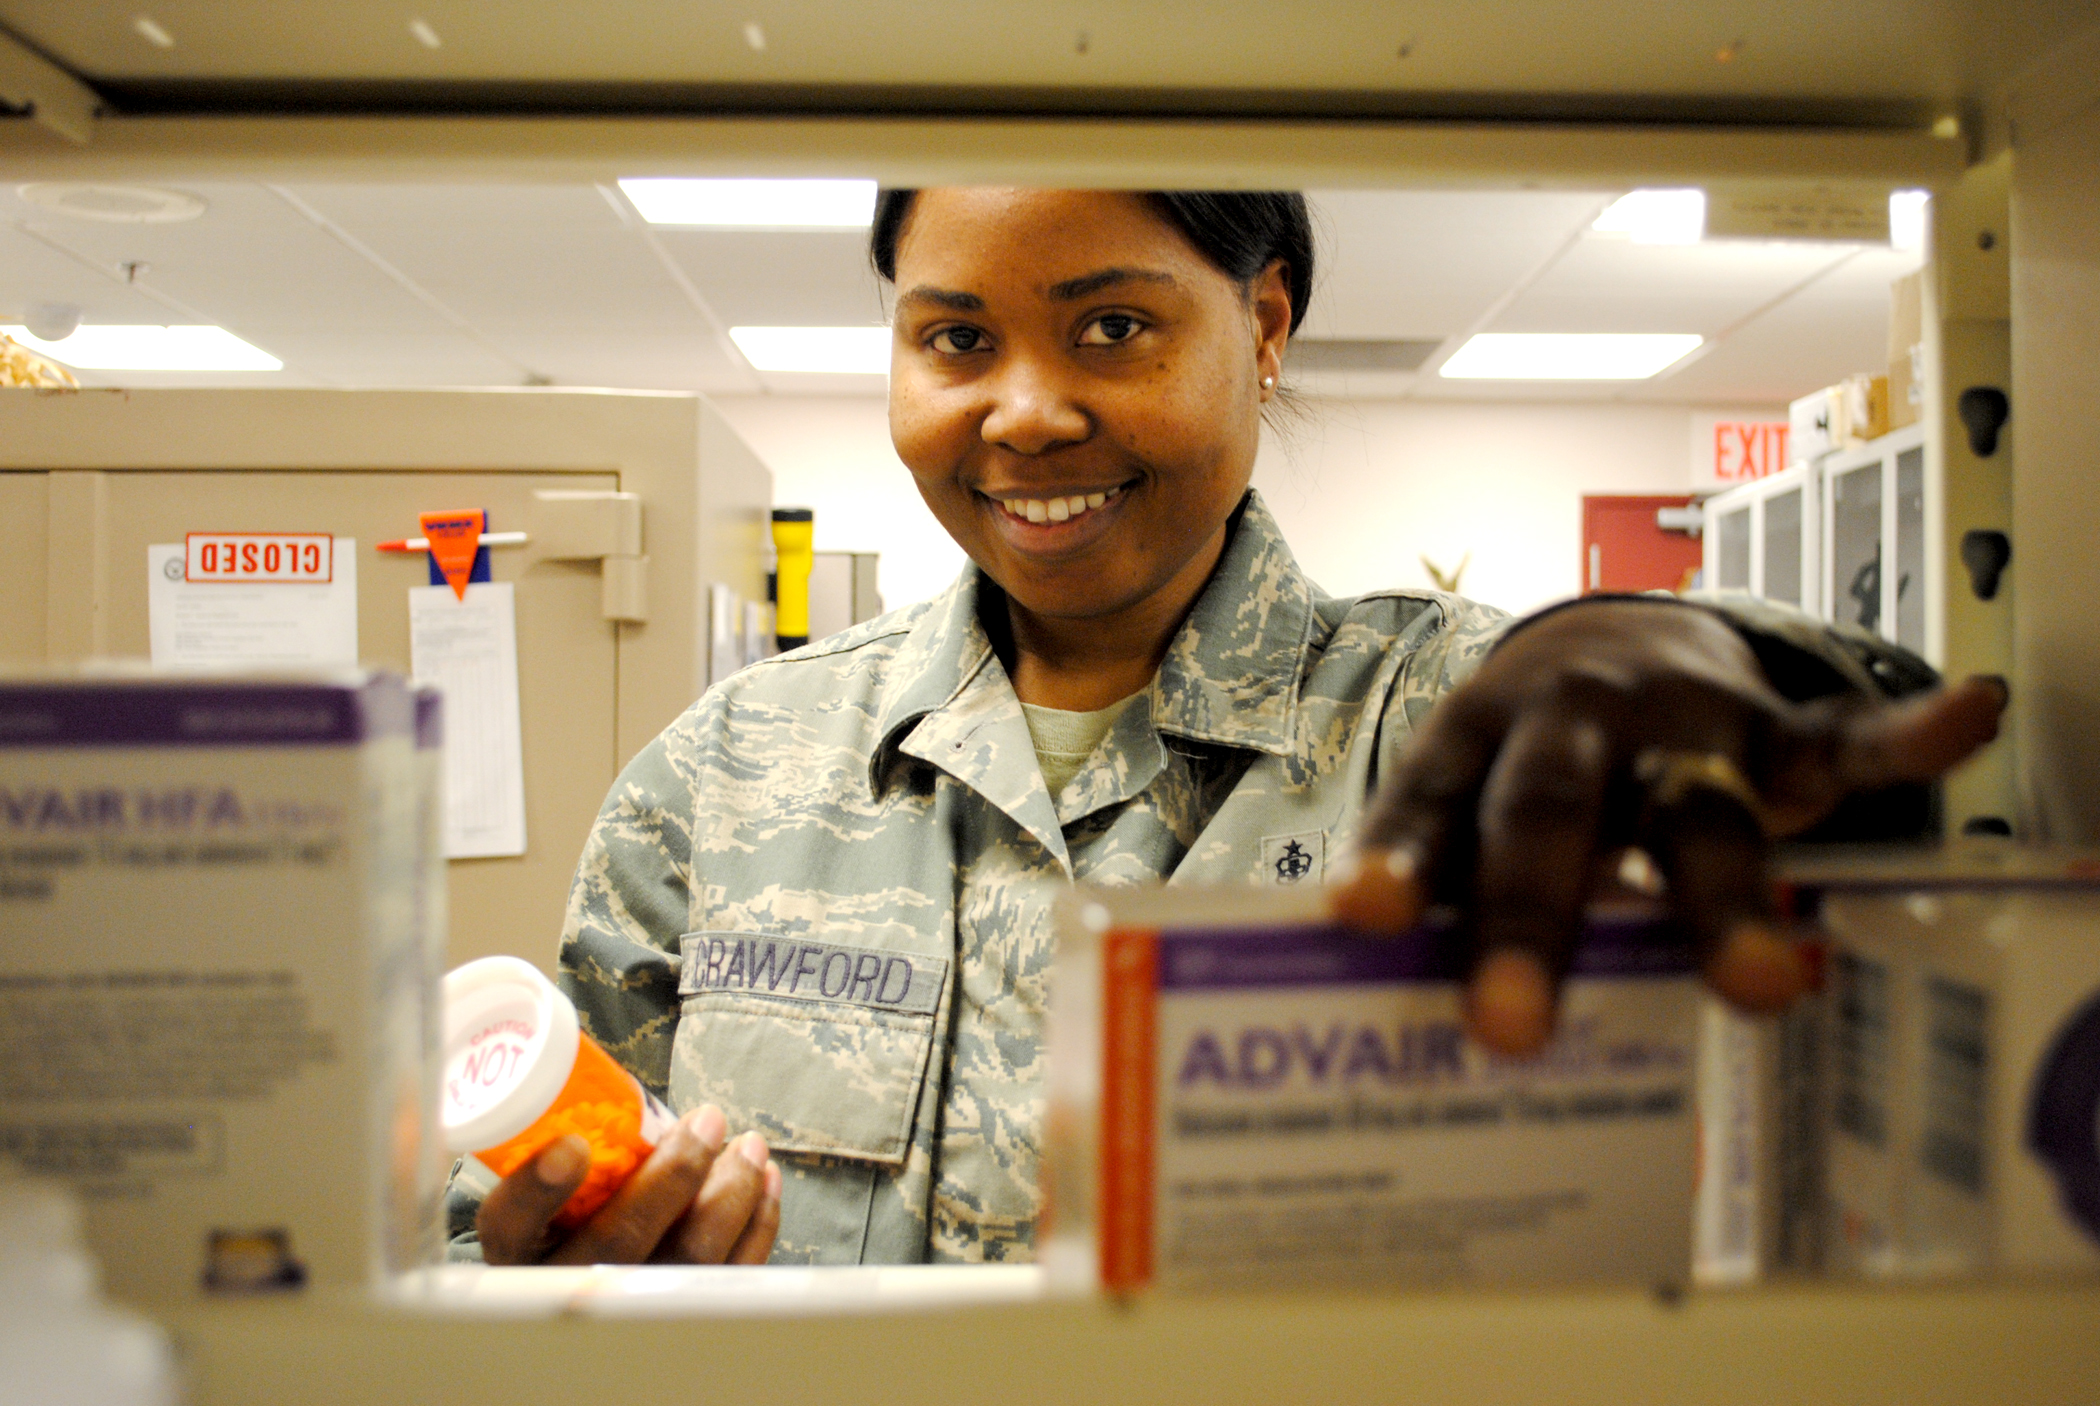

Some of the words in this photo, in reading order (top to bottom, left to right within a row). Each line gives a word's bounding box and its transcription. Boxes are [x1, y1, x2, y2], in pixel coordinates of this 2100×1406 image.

[1713, 421, 1790, 481] EXIT
[201, 543, 320, 573] CLOSED
[0, 787, 122, 830] VAIR
[690, 938, 913, 1004] CRAWFORD
[462, 1042, 524, 1087] NOT
[1178, 1021, 1464, 1087] ADVAIR
